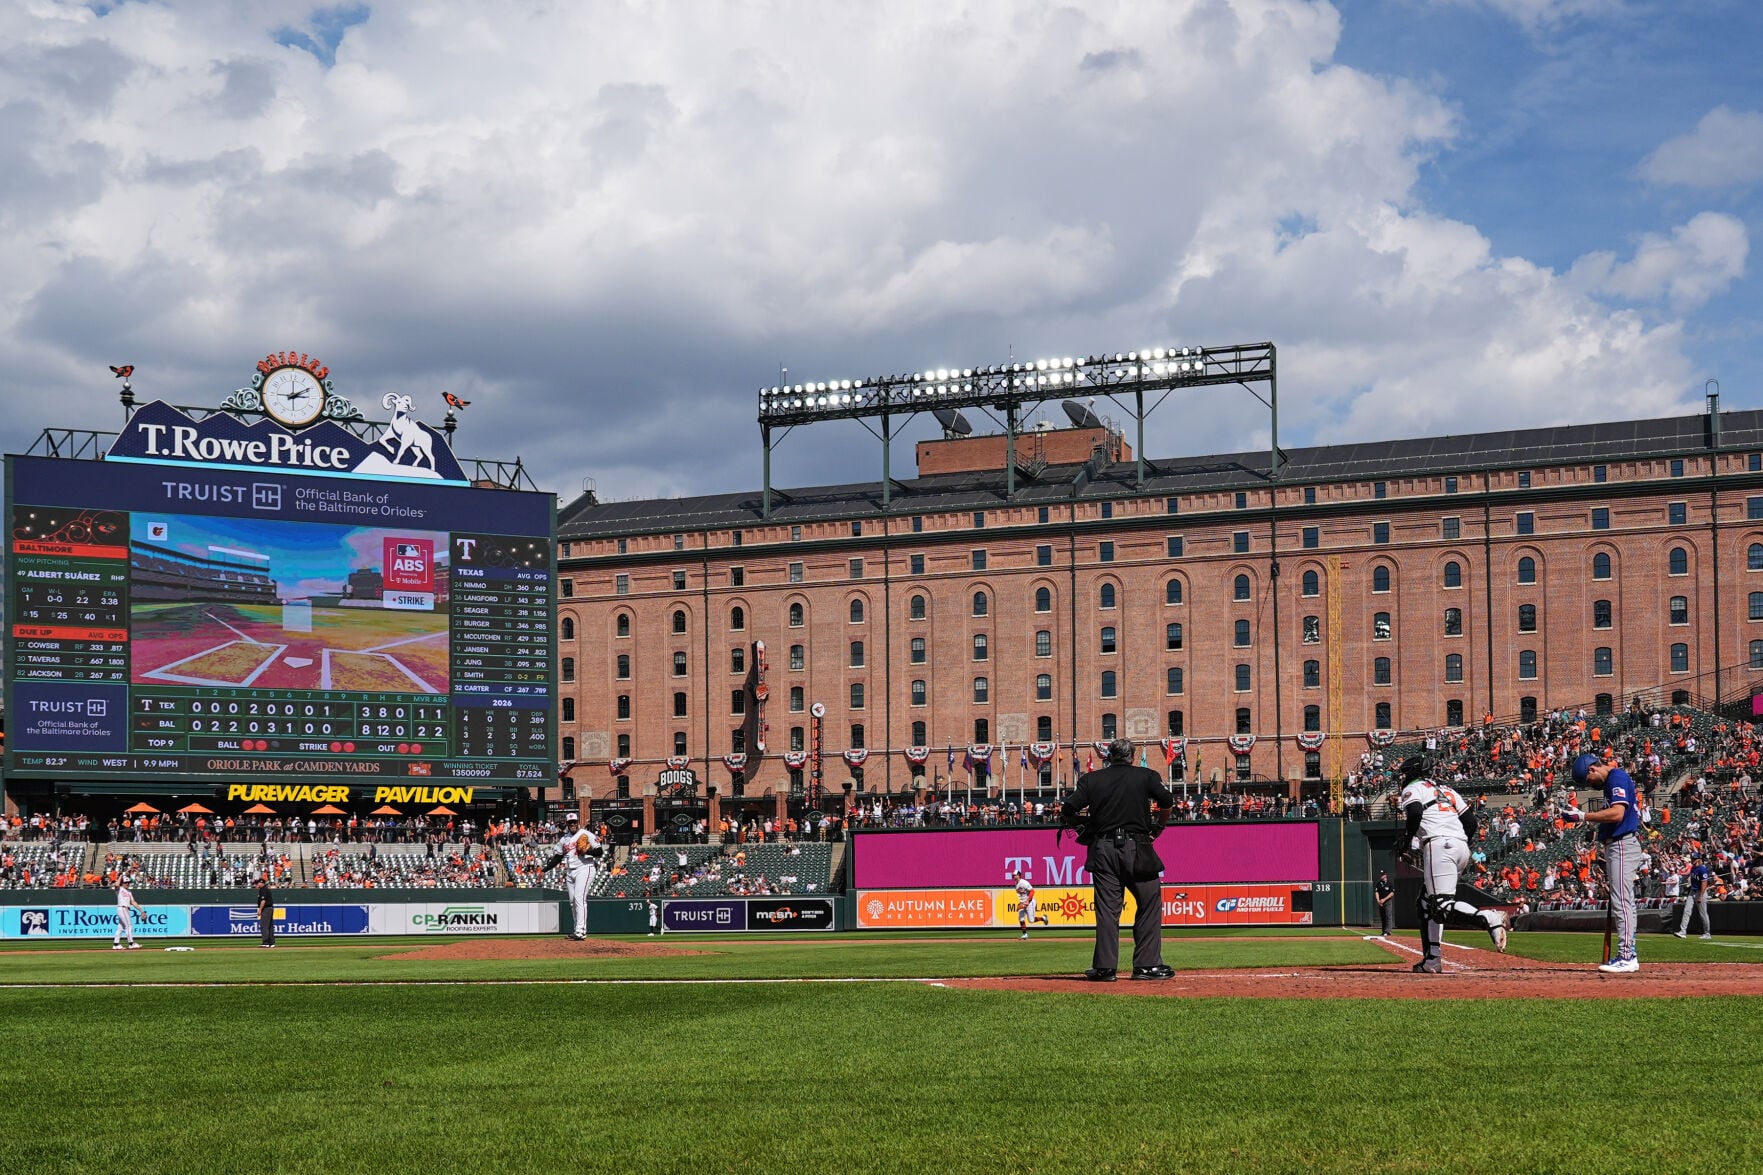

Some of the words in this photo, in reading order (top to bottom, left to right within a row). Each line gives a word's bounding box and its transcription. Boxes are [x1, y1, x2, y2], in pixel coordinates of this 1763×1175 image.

[256, 351, 330, 379] ORIOLES
[268, 433, 350, 469] Price
[162, 481, 247, 503] TRUIST
[295, 487, 341, 501] Official
[343, 490, 374, 503] Bank
[376, 493, 389, 504] of
[295, 500, 316, 511] the
[318, 501, 378, 515] Baltimore
[381, 505, 424, 518] Orioles
[19, 544, 73, 553] BALTIMORE
[36, 558, 70, 566] PITCHING
[393, 559, 424, 572] ABS
[28, 570, 63, 579] ALBERT
[64, 571, 100, 581] SUÁREZ
[458, 568, 484, 577] TEXAS
[398, 596, 425, 606] STRIKE
[463, 594, 498, 602] LANGFORD
[29, 700, 84, 713] TRUIST
[192, 702, 202, 713] 0
[210, 702, 220, 713] 0
[228, 703, 239, 714] 0
[249, 703, 258, 714] 2
[267, 703, 276, 714] 0
[284, 704, 294, 715] 0
[304, 705, 314, 716] 0
[323, 705, 329, 716] 1
[362, 706, 370, 717] 3
[378, 707, 387, 718] 8
[395, 707, 404, 718] 0
[419, 708, 424, 719] 1
[436, 708, 441, 719] 1
[37, 720, 67, 728] Official
[90, 721, 98, 729] of
[159, 720, 176, 728] BAL
[192, 720, 202, 731] 0
[211, 721, 220, 731] 2
[229, 721, 238, 732] 2
[249, 721, 259, 732] 0
[267, 722, 276, 732] 3
[286, 722, 292, 733] 1
[304, 723, 314, 734] 0
[322, 723, 331, 734] 0
[362, 724, 370, 735] 8
[376, 724, 390, 736] 12
[395, 725, 404, 736] 0
[418, 725, 426, 737] 2
[434, 726, 443, 737] 2
[82, 728, 111, 736] Orioles
[148, 739, 168, 747] TOP
[168, 739, 174, 747] 9
[217, 741, 240, 749] BALL
[299, 742, 328, 750] STRIKE
[377, 744, 396, 752] OUT
[158, 760, 178, 768] MPH
[207, 759, 251, 770] ORIOLE
[252, 760, 282, 771] PARK
[294, 761, 344, 772] CAMDEN
[345, 762, 380, 773] YARDS
[452, 769, 491, 777] 13500909
[227, 783, 350, 803] PUREWAGER
[374, 786, 474, 804] PAVILION
[1316, 883, 1331, 892] 318
[628, 903, 643, 911] 373
[887, 900, 945, 911] AUTUMN
[950, 899, 984, 911] LAKE
[1237, 896, 1285, 908] CARROLL
[673, 910, 714, 921] TRUIST
[887, 912, 985, 920] HEALTHCARE
[287, 921, 333, 933] Health
